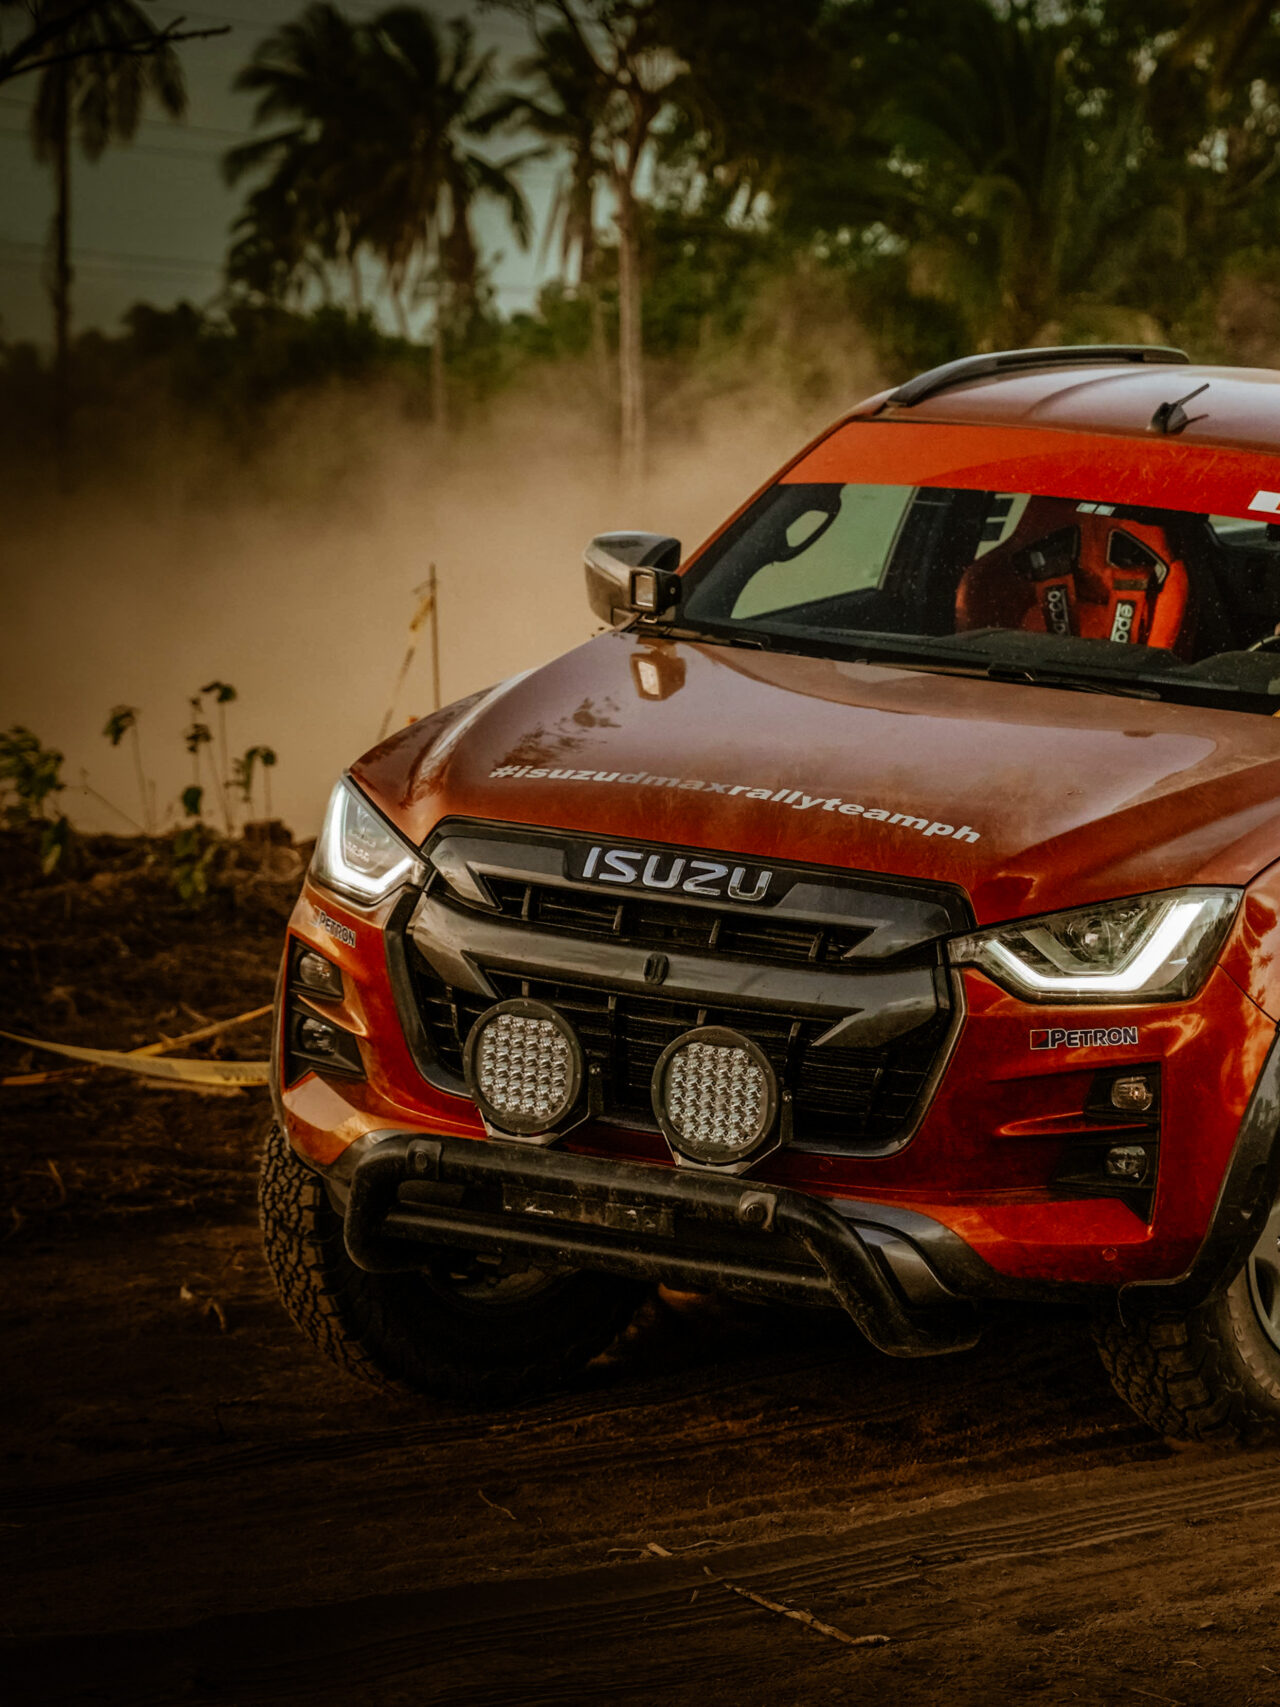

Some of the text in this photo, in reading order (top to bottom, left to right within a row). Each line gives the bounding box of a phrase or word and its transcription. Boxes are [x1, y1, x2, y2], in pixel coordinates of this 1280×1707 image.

[489, 764, 981, 845] #isuzudmaxrallyteamph
[582, 847, 773, 901] ISUZU
[320, 909, 357, 948] PETRON
[1049, 1026, 1139, 1049] PETRON
